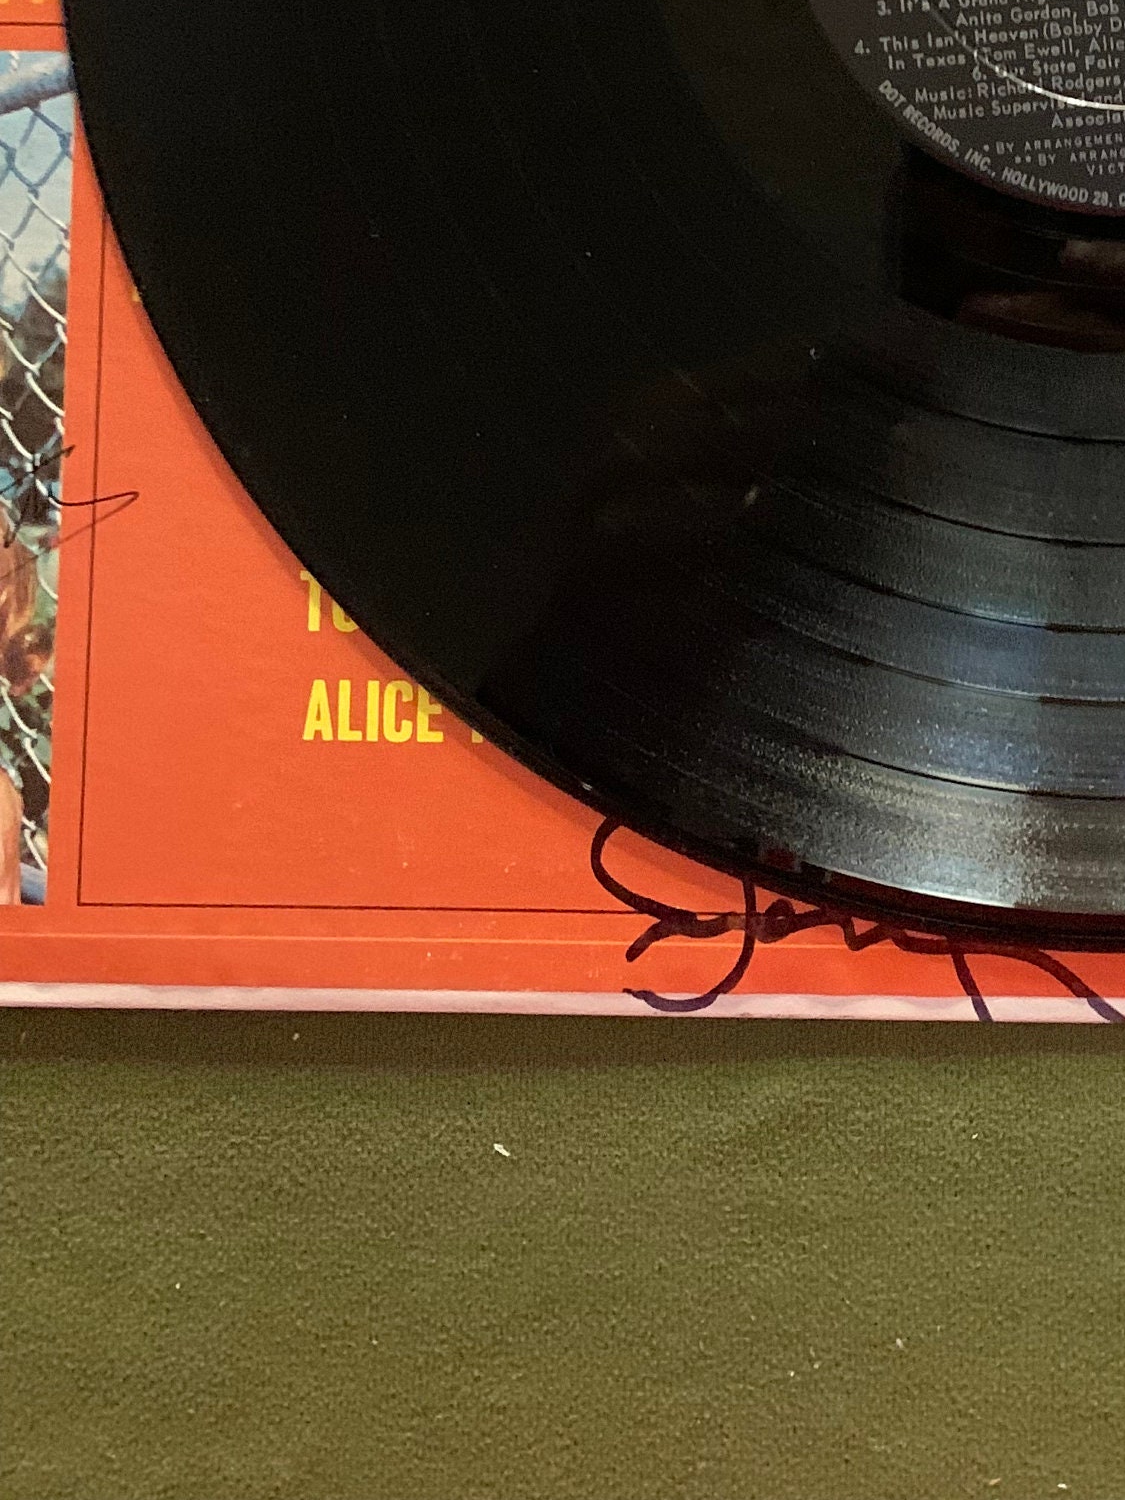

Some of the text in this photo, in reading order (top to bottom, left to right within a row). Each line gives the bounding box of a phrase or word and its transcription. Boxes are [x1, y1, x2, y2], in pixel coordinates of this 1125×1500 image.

[877, 0, 891, 17] 3.
[956, 10, 1002, 27] Anita
[1011, 3, 1077, 24] Gordon,
[1087, 0, 1119, 17] Bob
[855, 40, 870, 55] 4.
[879, 36, 919, 52] This
[974, 28, 1039, 44] Heaven
[1043, 20, 1102, 39] (Bobby
[888, 55, 904, 71] In
[913, 52, 966, 69] Texas
[1024, 40, 1080, 60] Ewell,
[1032, 59, 1076, 76] State
[1085, 54, 1120, 70] Fair
[915, 86, 973, 103] Music:
[934, 105, 984, 121] Music
[878, 79, 907, 107] DOT
[903, 103, 961, 158] RECORDS,
[1002, 166, 1088, 204] HOLLYWOOD
[303, 679, 444, 743] ALICE
